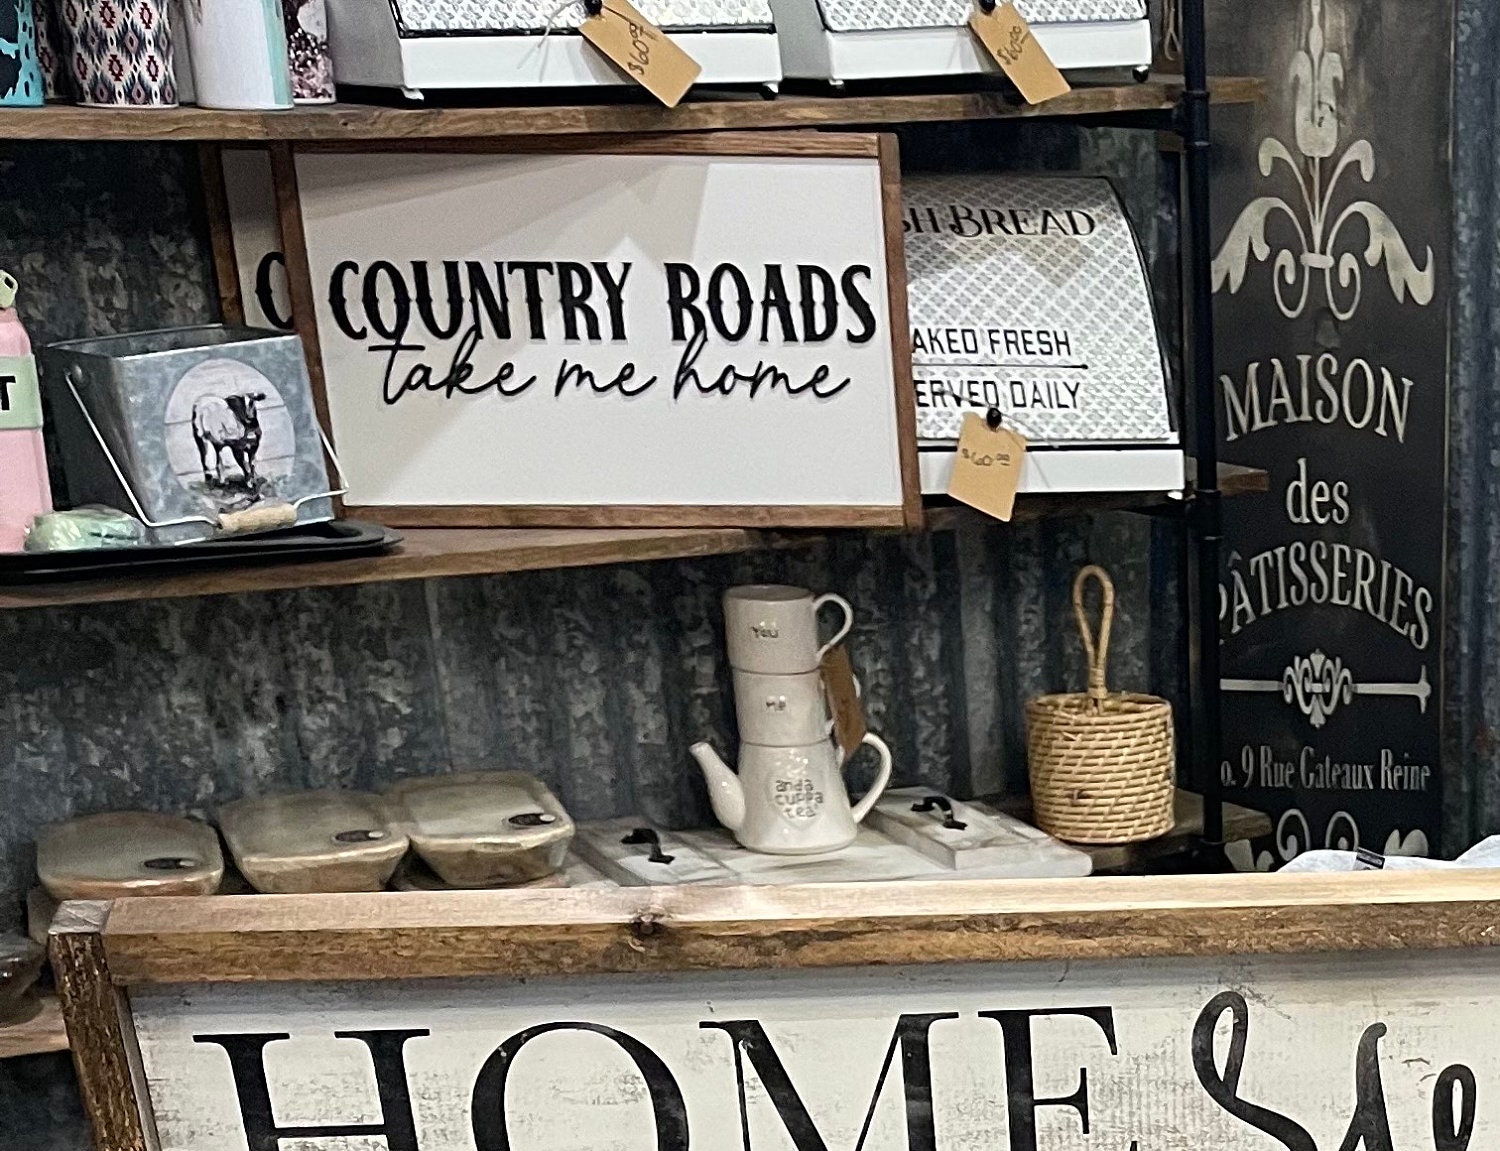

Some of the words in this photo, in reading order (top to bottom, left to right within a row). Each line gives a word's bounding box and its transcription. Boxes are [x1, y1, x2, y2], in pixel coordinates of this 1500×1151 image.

[328, 260, 633, 342] COUNTRY
[664, 262, 877, 344] ROADS
[368, 325, 537, 405] take
[554, 359, 657, 398] me
[673, 327, 850, 403] home
[912, 328, 978, 355] AKED
[987, 329, 1071, 357] FRESH
[913, 379, 1000, 408] ERVED
[1009, 380, 1080, 409] DAILY
[1219, 353, 1414, 443] MAISON
[1286, 457, 1350, 525] des
[1220, 760, 1236, 787] o.
[1241, 745, 1254, 788] 9
[1260, 745, 1295, 788] Rue
[1380, 748, 1431, 790] Reine
